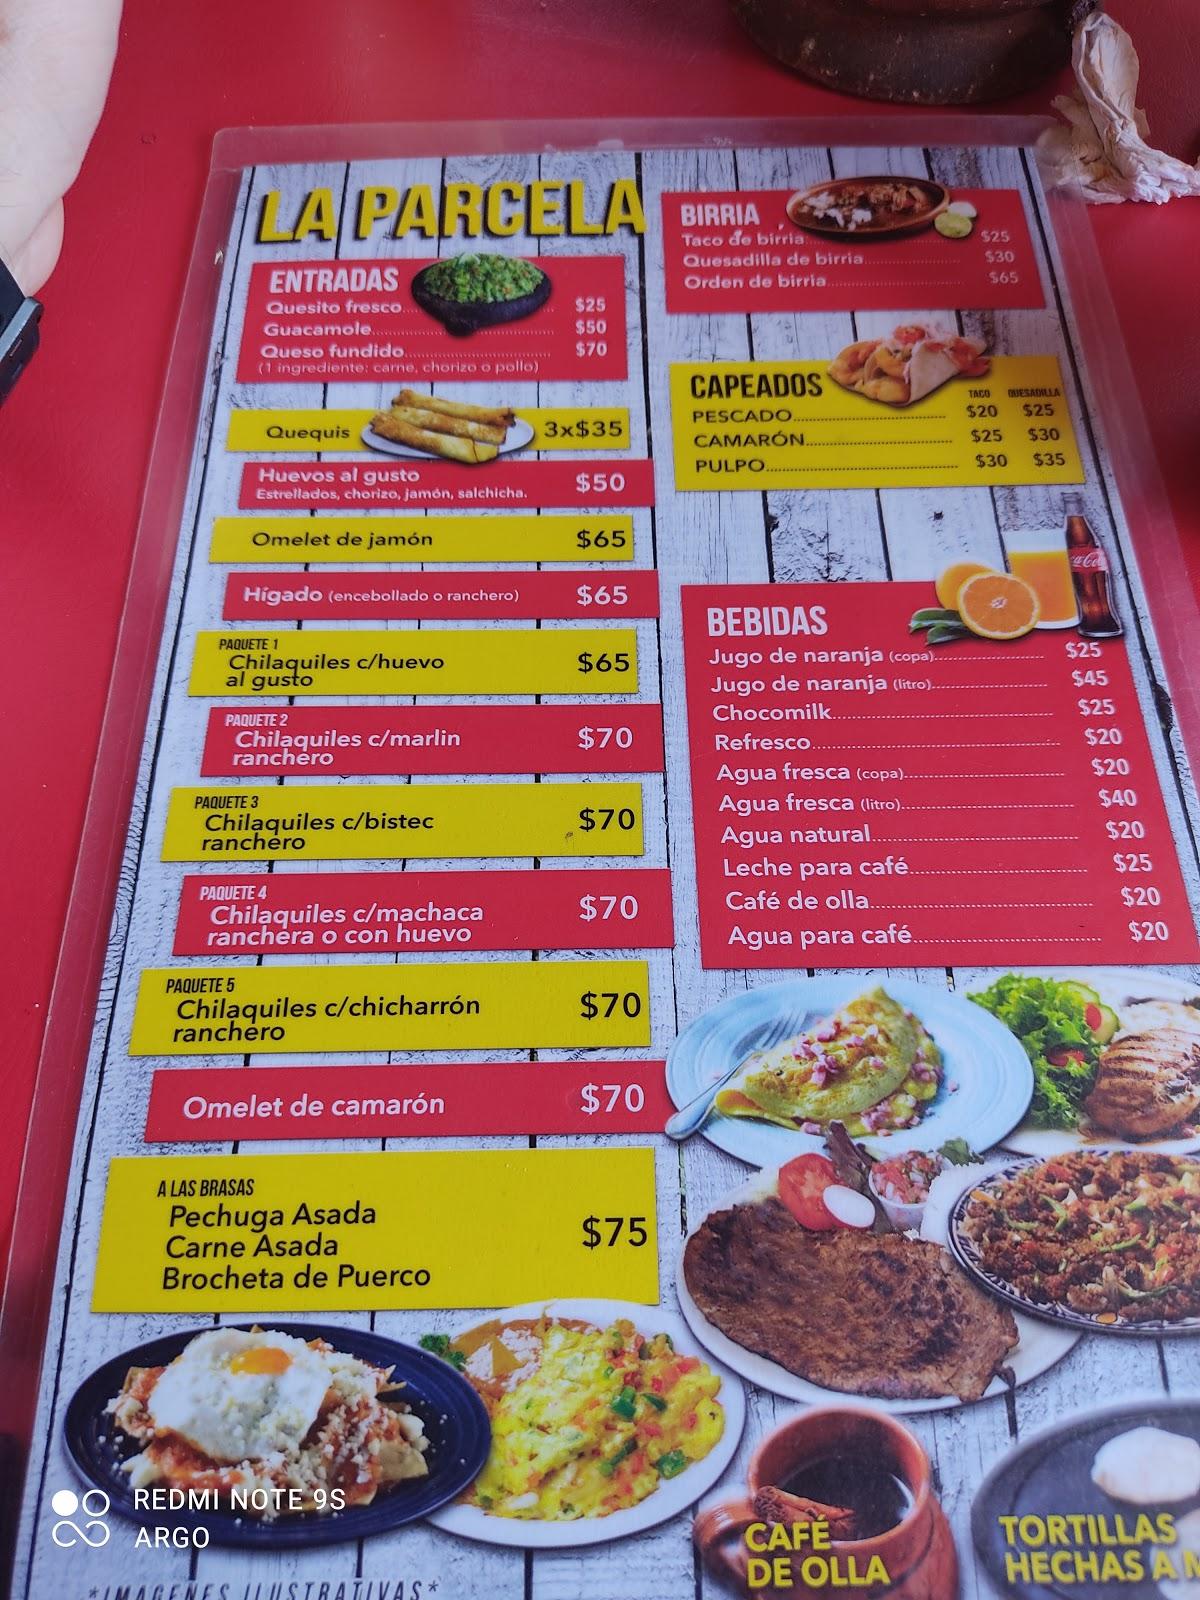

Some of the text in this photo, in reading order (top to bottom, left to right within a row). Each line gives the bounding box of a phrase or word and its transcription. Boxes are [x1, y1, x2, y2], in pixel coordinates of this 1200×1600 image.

[259, 180, 648, 242] LA PARCELA
[681, 204, 759, 226] BIRRIA
[682, 230, 1010, 246] Taco de birria $25
[683, 251, 1014, 267] Quesadilla de birria $30
[270, 267, 398, 293] ENTRADAS
[685, 271, 1018, 289] Orden de birria $65
[266, 297, 605, 314] Quesito fresco $25
[264, 320, 606, 336] Guacamole $50
[261, 342, 607, 358] Queso fundido $70
[277, 361, 368, 376] ingrediente:
[423, 361, 476, 372] chorizo
[481, 364, 491, 372] o
[496, 360, 538, 374] pollo)
[691, 373, 822, 398] CAPEADOS
[969, 388, 1061, 398] TACO QUESADILLA
[693, 404, 1054, 423] PESCADO $20 $25
[267, 420, 622, 442] Quequis 3x$35
[694, 428, 1060, 447] CAMARÓN $25 $30
[696, 453, 1065, 472] PULPO $30 $35
[259, 467, 624, 493] Huevos al gusto $50
[256, 487, 527, 501] Estrellados, chorizo, jamón, salchicha.
[253, 530, 625, 550] Omelet de jamón $65
[244, 585, 627, 606] Hígado (encebollado o ranchero) $65
[708, 606, 827, 636] BEBIDAS
[219, 639, 278, 650] PAQUETE 1
[709, 642, 1101, 668] Jugo de naranja (copa) $25
[230, 652, 629, 678] Chilaquiles c/huevo $65
[226, 671, 313, 691] al gusto
[711, 670, 1108, 696] Jugo de naranja (litro) $45
[226, 714, 288, 727] PAQUETE 2
[713, 699, 1115, 721] Chocomilk $25
[236, 726, 632, 751] Chilaquiles c/marlin $70
[716, 728, 1122, 750] Refresco $20
[233, 748, 333, 765] ranchero
[717, 758, 1129, 785] Agua fresca (copa) $20
[195, 796, 258, 809] PAQUETE 3
[719, 789, 1137, 816] Agua fresca (litro) $40
[206, 807, 634, 835] Chilaquiles c/bistec $70
[202, 832, 305, 850] ranchero
[721, 820, 1144, 848] Agua natural $20
[724, 853, 1152, 881] Leche para café $25
[200, 886, 266, 900] PAQUETE 4
[726, 886, 1160, 910] Café de olla $20
[210, 894, 638, 930] Chilaquiles c/machaca $70
[208, 923, 471, 945] ranchera o con huevo
[728, 921, 1168, 950] Agua para café $20
[166, 978, 235, 993] PAQUETE 5
[177, 991, 640, 1024] Chilaquiles c/chicharrón $70
[174, 1020, 285, 1042] ranchero
[184, 1083, 644, 1119] Omelet de camarón $70
[157, 1179, 254, 1197] A LAS BRASAS
[170, 1200, 647, 1250] Pechuga Asada $75
[167, 1233, 338, 1258] Carne Asada
[163, 1264, 430, 1289] Brocheta de Puerco
[745, 1515, 831, 1551] CAFÉ
[998, 1513, 1177, 1547] TORTILLAS
[747, 1553, 892, 1588] DE OLLA
[1005, 1549, 1144, 1584] HECHAS
[1153, 1550, 1177, 1581] A
